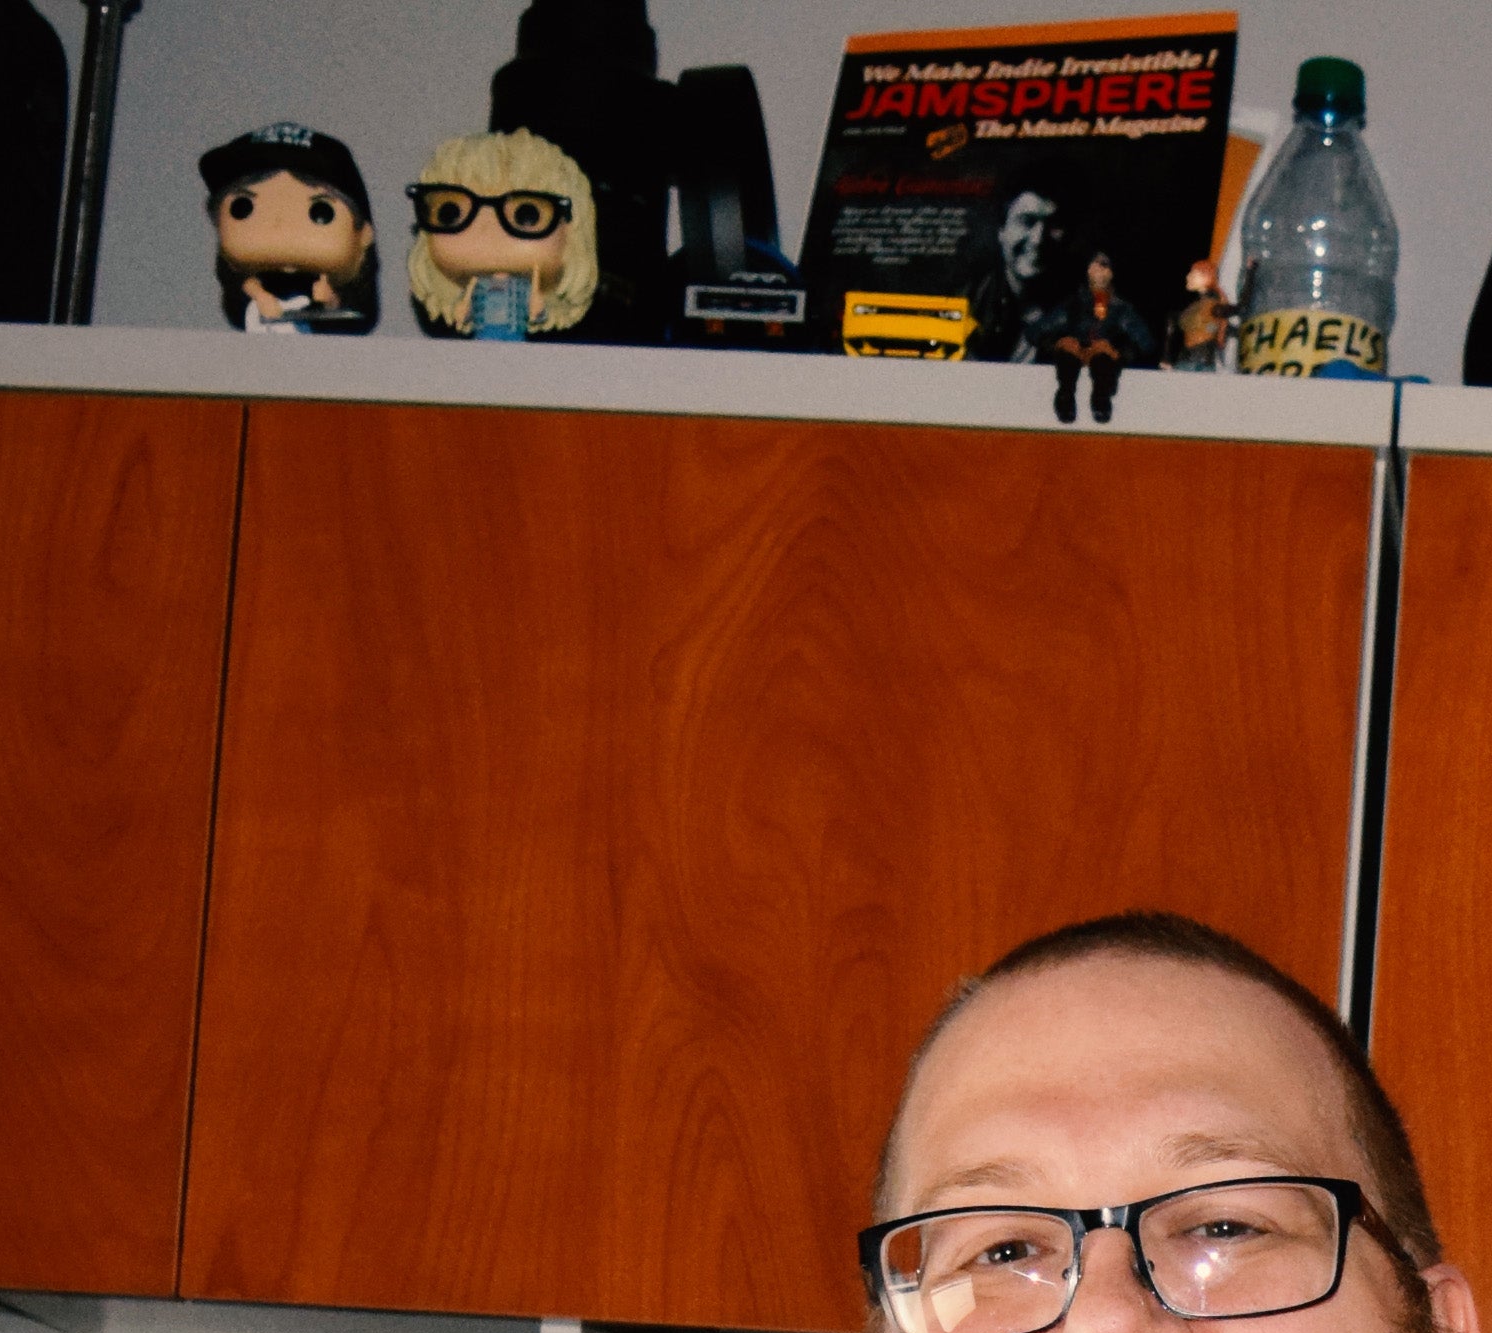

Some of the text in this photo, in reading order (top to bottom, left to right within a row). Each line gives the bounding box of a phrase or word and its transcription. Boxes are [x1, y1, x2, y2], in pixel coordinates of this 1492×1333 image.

[904, 62, 983, 82] Make
[984, 58, 1057, 80] Indie
[1059, 50, 1203, 77] Irresistible
[845, 70, 1216, 121] JAMSPHERE
[974, 114, 1208, 140] The Music Magazine
